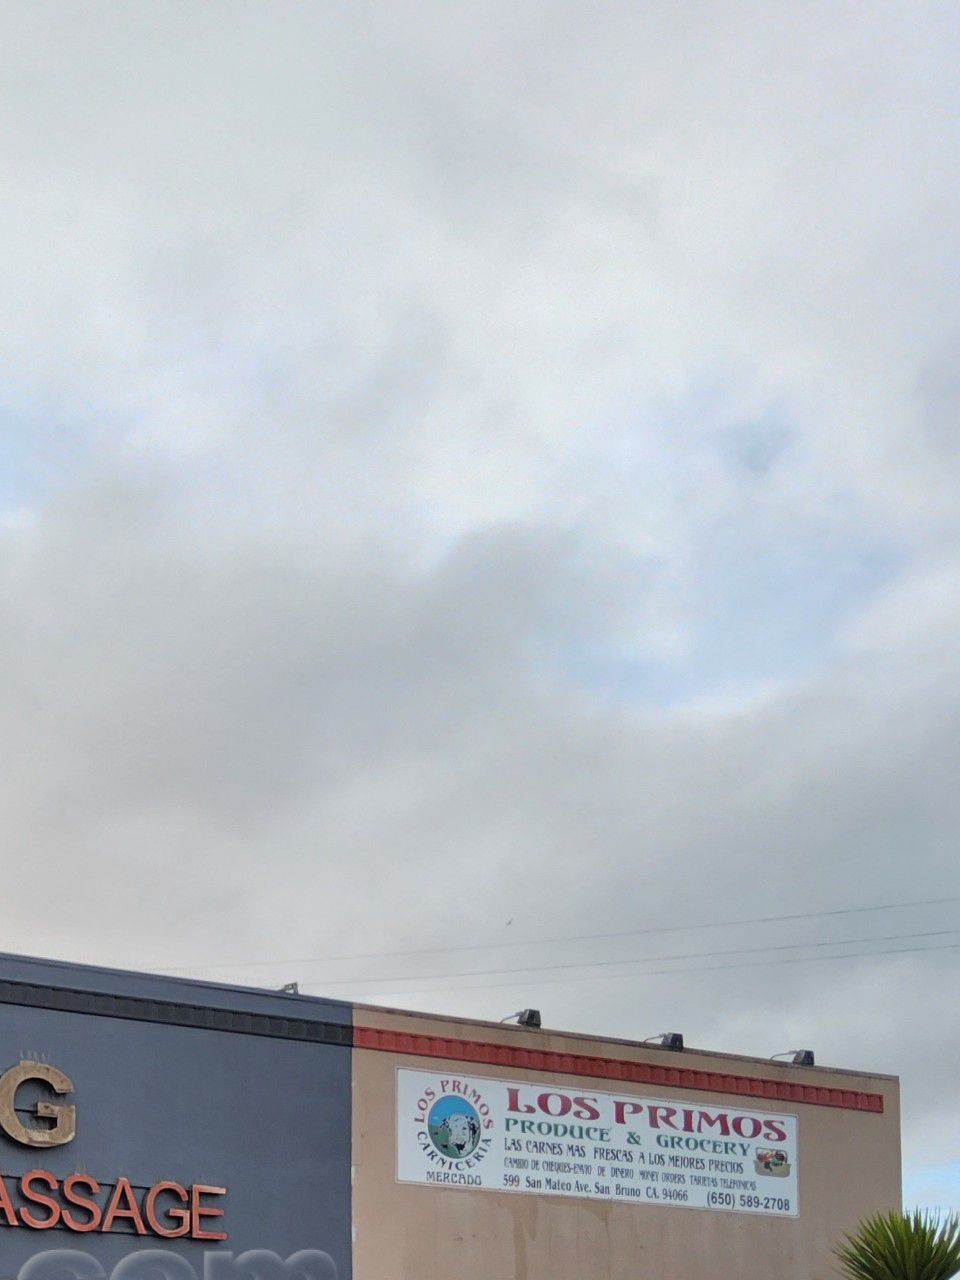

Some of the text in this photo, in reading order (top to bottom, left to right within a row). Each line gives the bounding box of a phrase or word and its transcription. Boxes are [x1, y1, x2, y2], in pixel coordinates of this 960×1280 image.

[414, 1079, 494, 1130] LOS PRIMOS
[507, 1088, 787, 1142] LOS PRIMOS
[416, 1131, 492, 1171] CARNICERIA
[503, 1137, 522, 1151] LAS
[526, 1139, 563, 1156] CARNES
[566, 1144, 586, 1158] MAS
[593, 1147, 634, 1163] FRESCAS
[638, 1152, 646, 1164] A
[648, 1153, 665, 1166] LOS
[708, 1159, 744, 1174] PRECIOS
[505, 1117, 751, 1157] PRODUCE & GROCERY
[426, 1170, 482, 1186] MERCADO
[531, 1159, 540, 1171] DE
[597, 1166, 606, 1177] DE
[610, 1167, 634, 1179] DINERO
[639, 1169, 660, 1182] MONEY
[662, 1172, 686, 1185] ORDERS
[503, 1174, 520, 1187] 599
[525, 1176, 542, 1189] San
[544, 1178, 572, 1192] Mateo
[594, 1182, 610, 1195] San
[615, 1184, 641, 1197] Bruno
[662, 1188, 689, 1201] 94066
[706, 1191, 736, 1209] (650)
[740, 1195, 790, 1211] 589-2708
